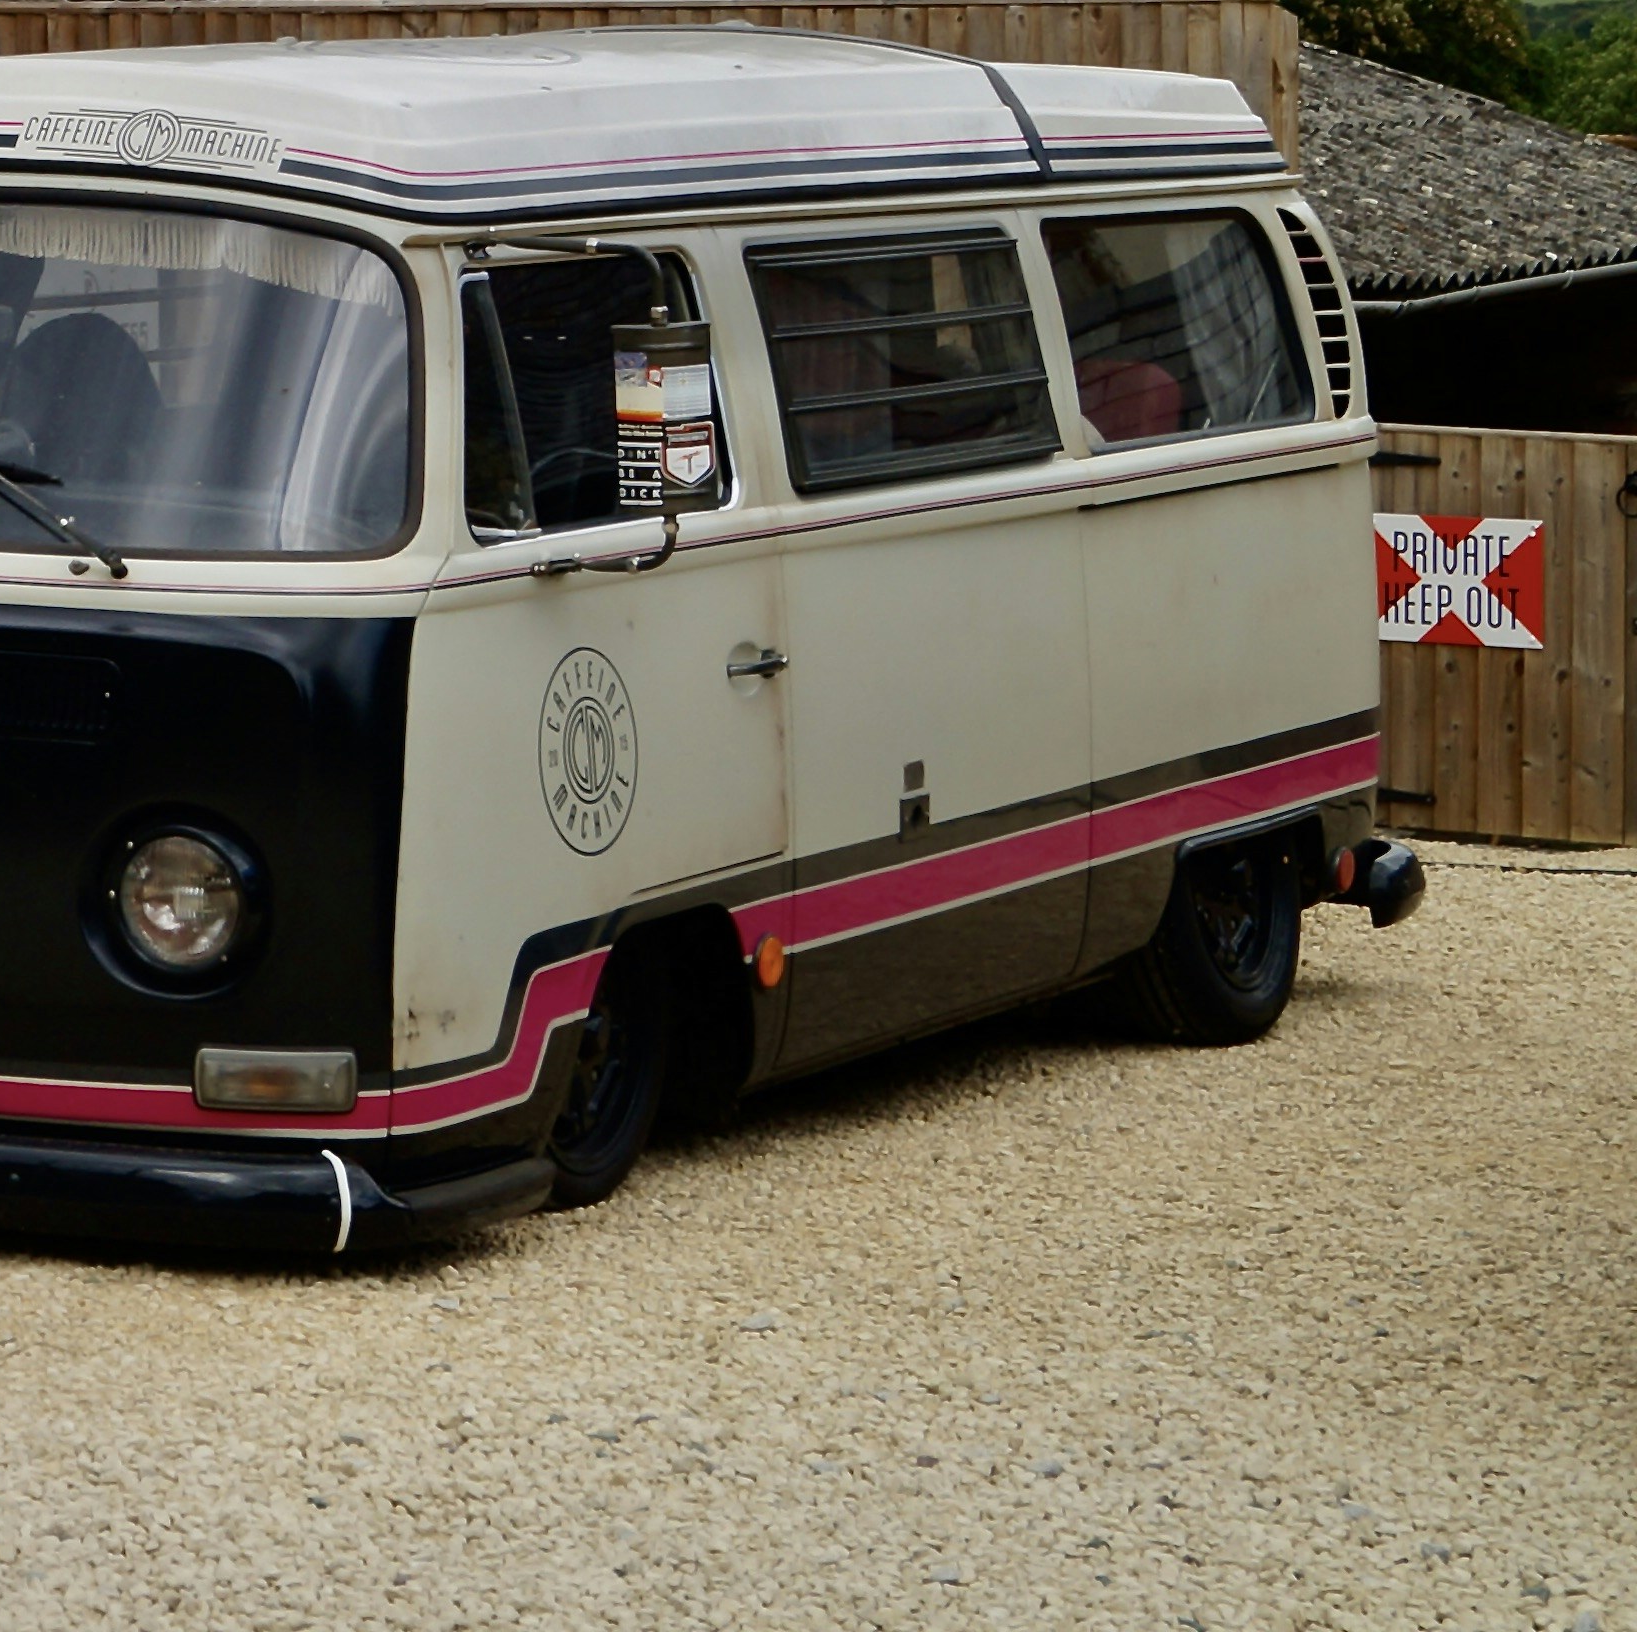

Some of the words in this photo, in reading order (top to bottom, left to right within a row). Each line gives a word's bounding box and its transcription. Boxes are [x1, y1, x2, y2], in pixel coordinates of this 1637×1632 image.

[24, 117, 118, 147] CAFFEINE
[180, 128, 282, 164] MACHINE
[618, 487, 661, 499] DICK
[1393, 531, 1511, 578] PRIVATE
[1384, 581, 1453, 626] KEEP
[1466, 586, 1520, 631] OUT
[546, 660, 626, 733] CAFFEINE
[552, 770, 629, 840] MACHINE
